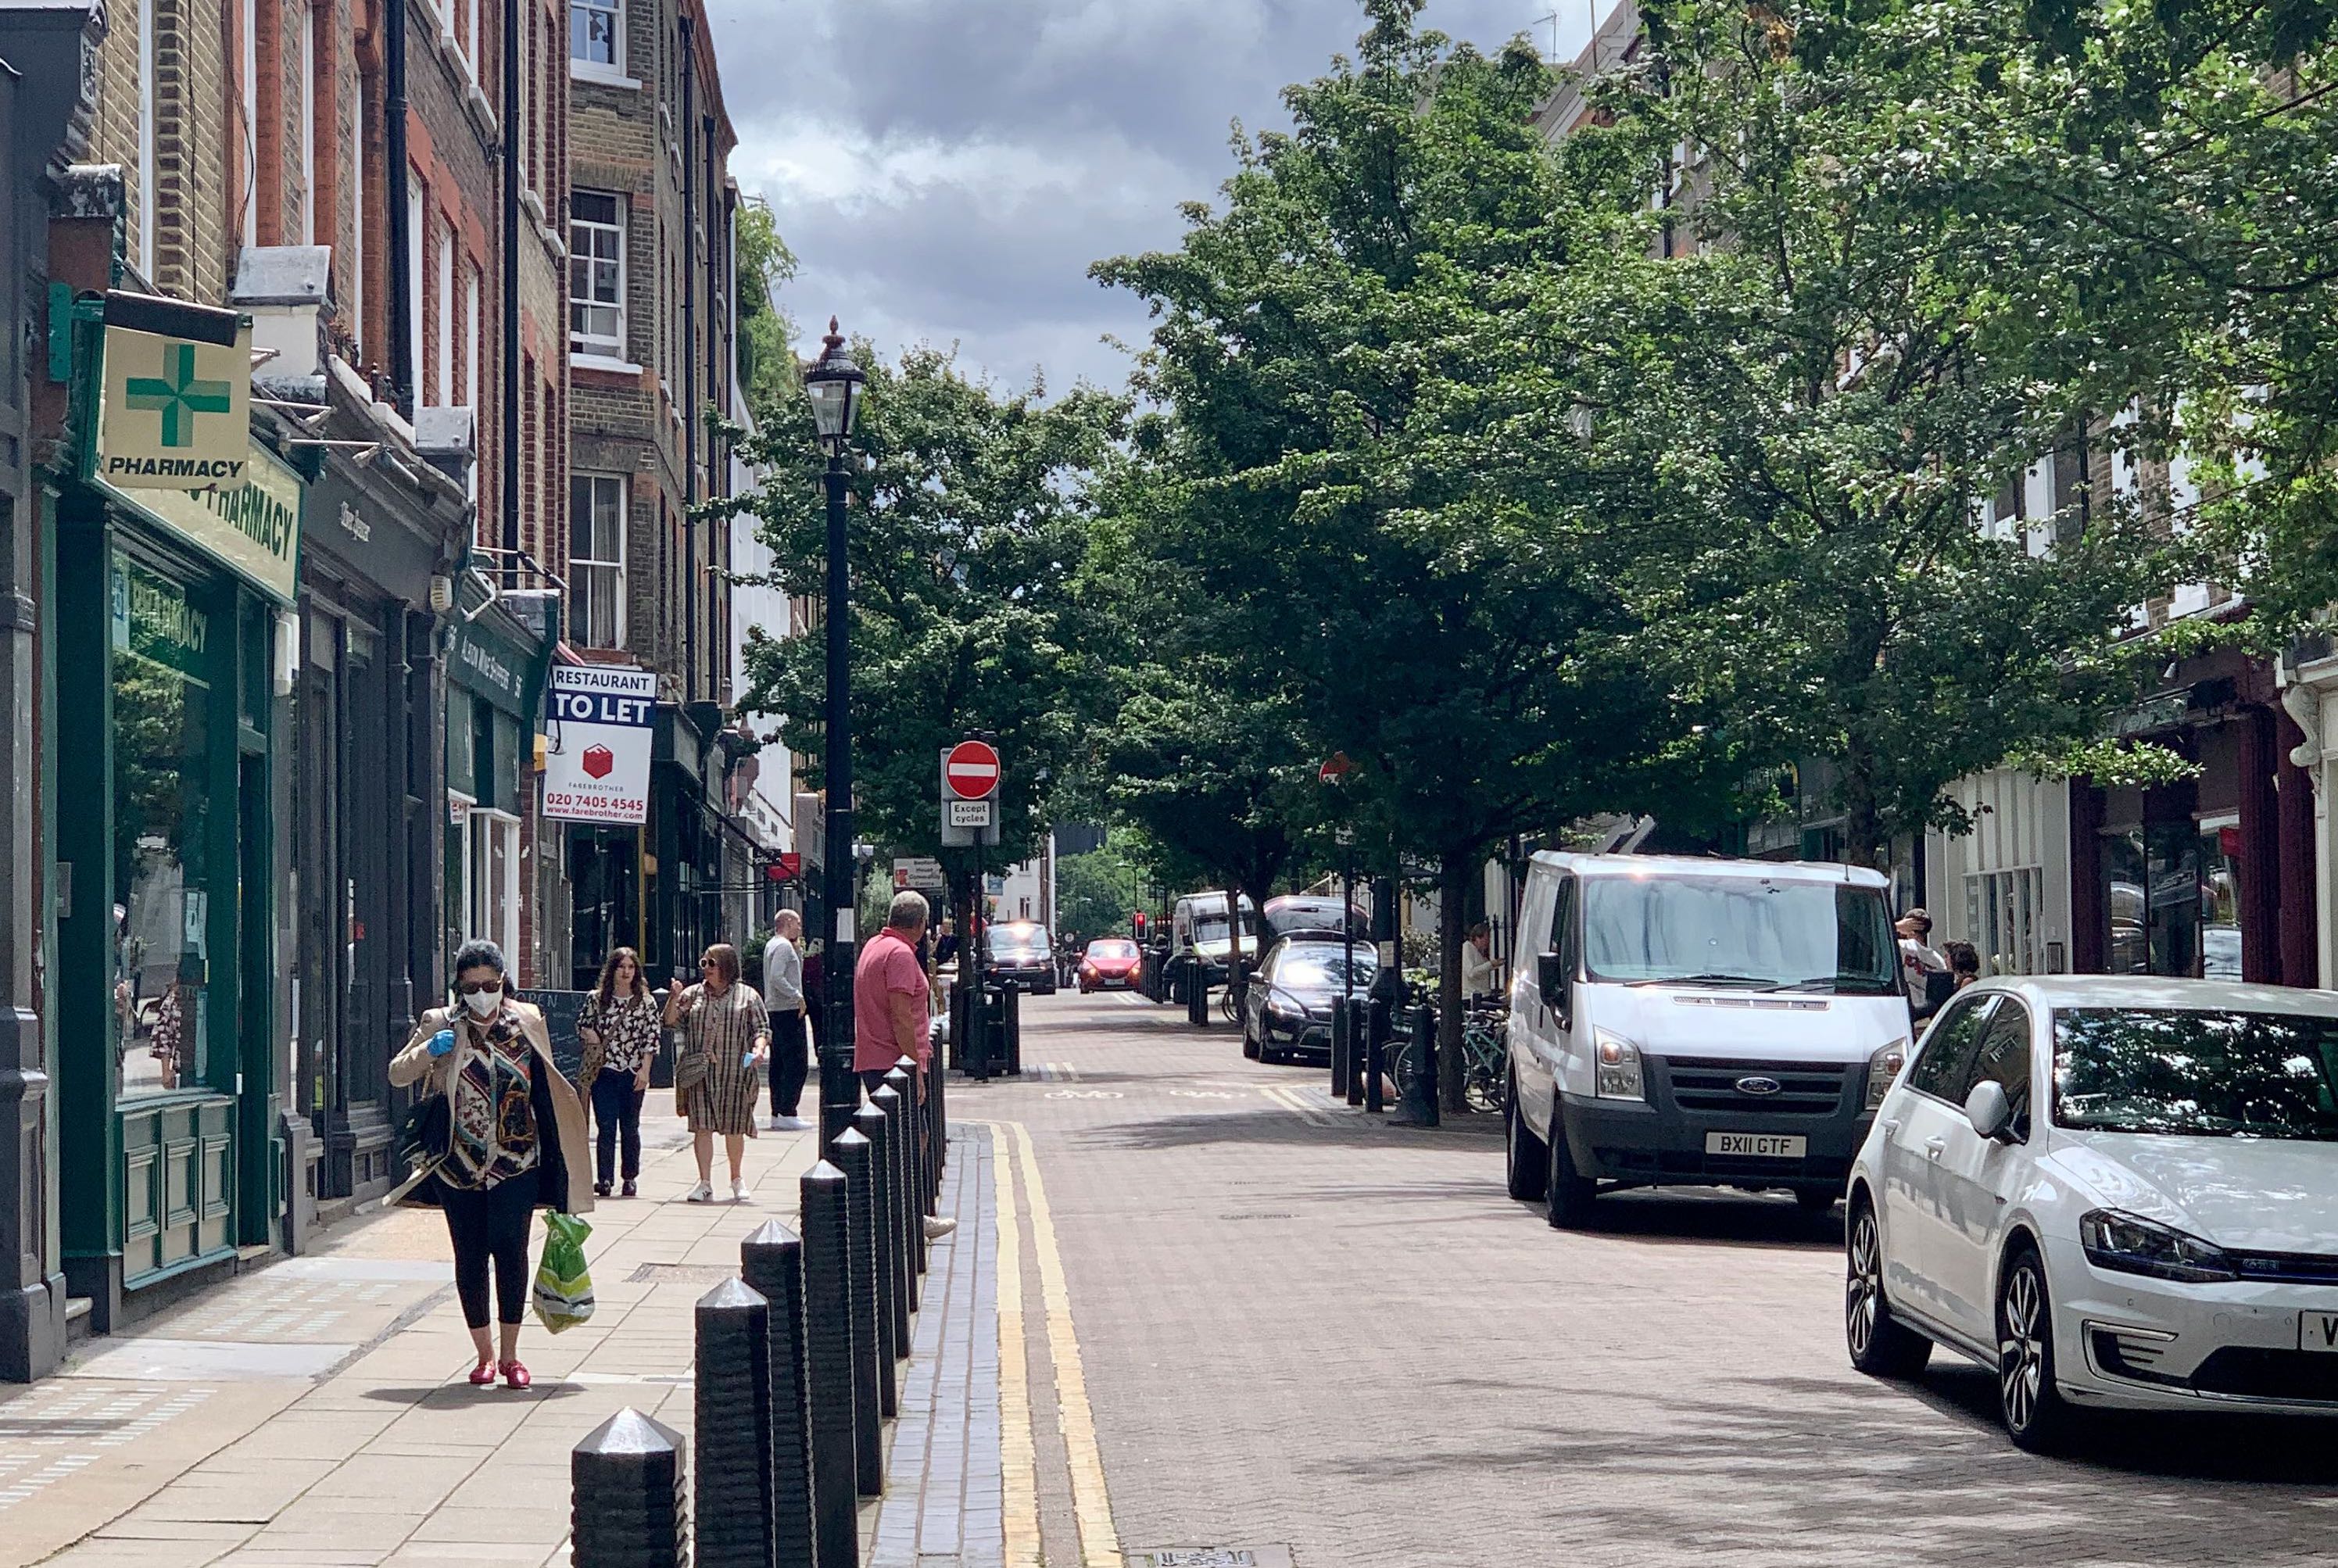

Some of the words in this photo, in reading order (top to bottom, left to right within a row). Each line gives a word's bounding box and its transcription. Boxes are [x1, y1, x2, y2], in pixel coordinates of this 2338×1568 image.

[109, 456, 244, 478] PHARMACY
[556, 670, 650, 690] RESTAURANT
[556, 693, 593, 719] TO
[600, 696, 651, 724] LET
[547, 793, 571, 805] 020
[575, 795, 607, 808] 7405
[610, 798, 643, 811] 4545
[954, 804, 986, 813] Except
[546, 807, 643, 819] www.farebrother.com
[955, 814, 984, 823] cycles
[1720, 1136, 1753, 1153] BX11
[1758, 1138, 1792, 1155] GTF
